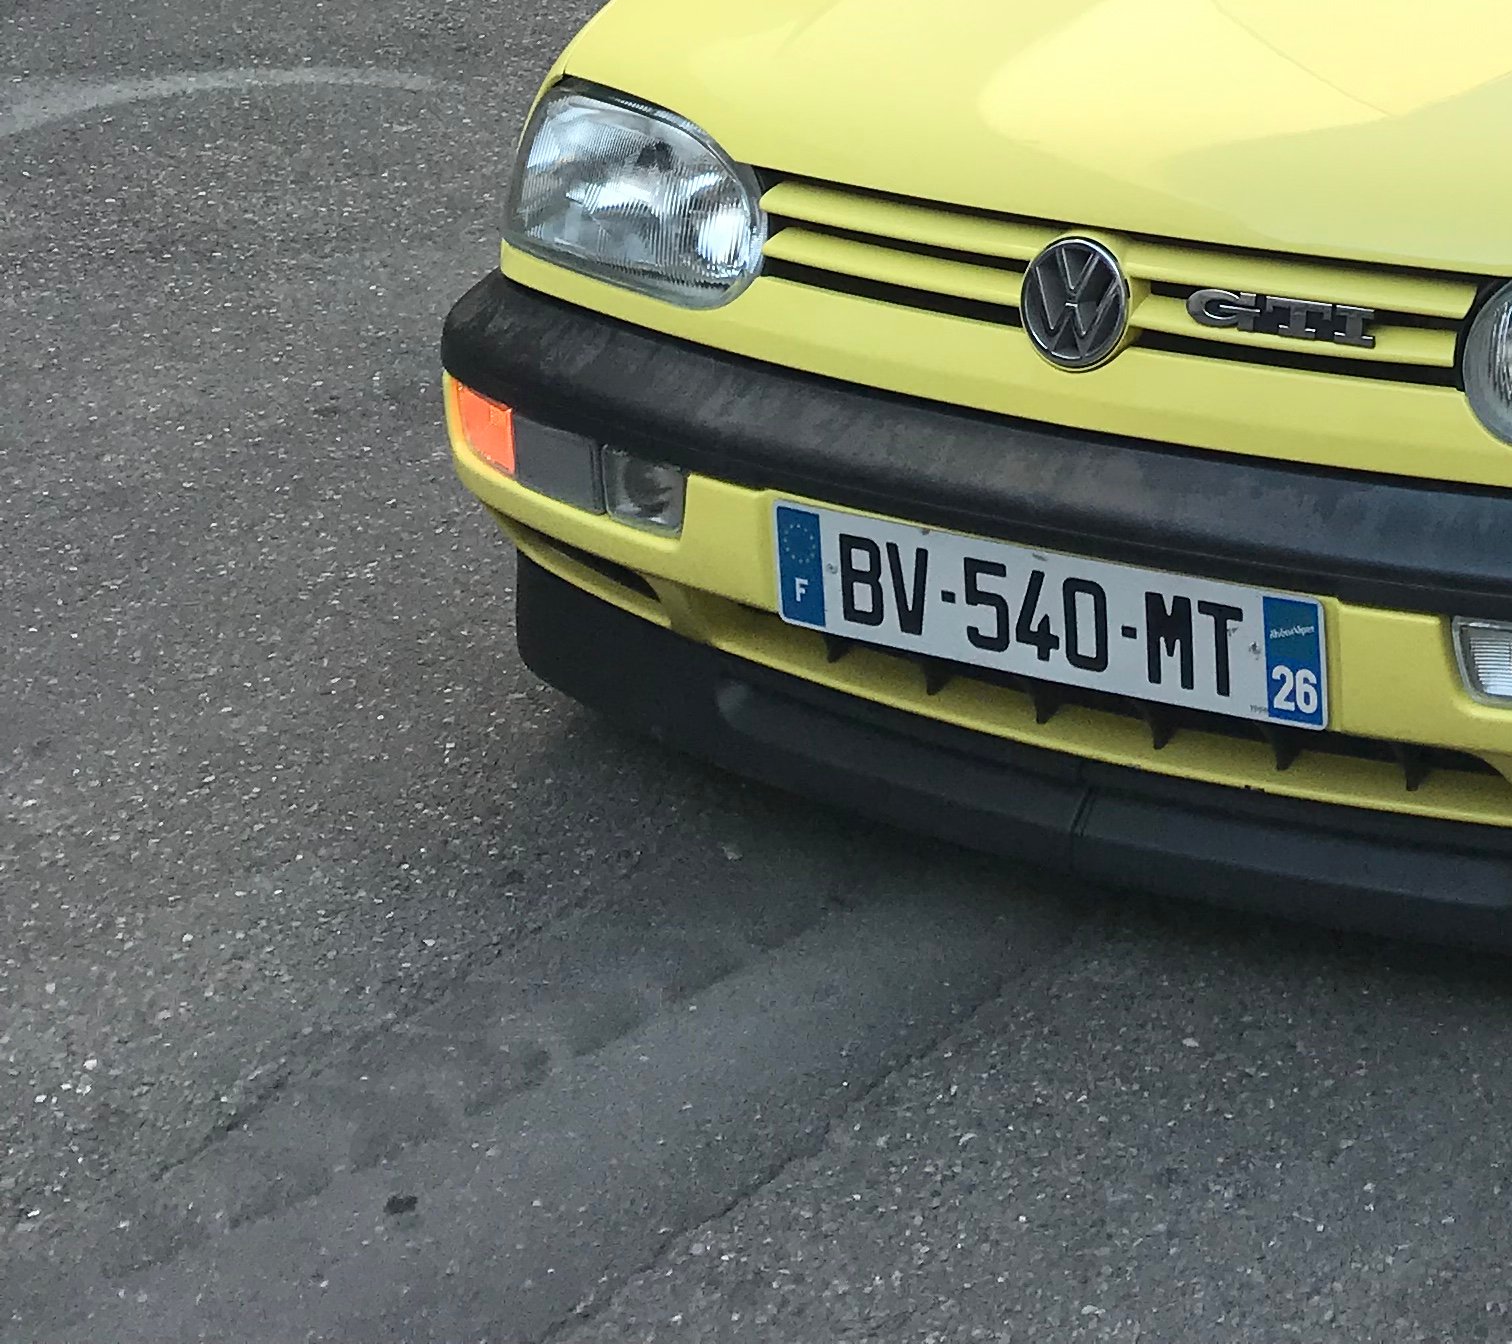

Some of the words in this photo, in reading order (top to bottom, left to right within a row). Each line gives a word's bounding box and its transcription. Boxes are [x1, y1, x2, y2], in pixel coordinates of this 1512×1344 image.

[1186, 288, 1376, 349] GTI
[795, 576, 809, 602] F
[838, 532, 1244, 697] BV-540-MT
[1271, 664, 1318, 714] 26
